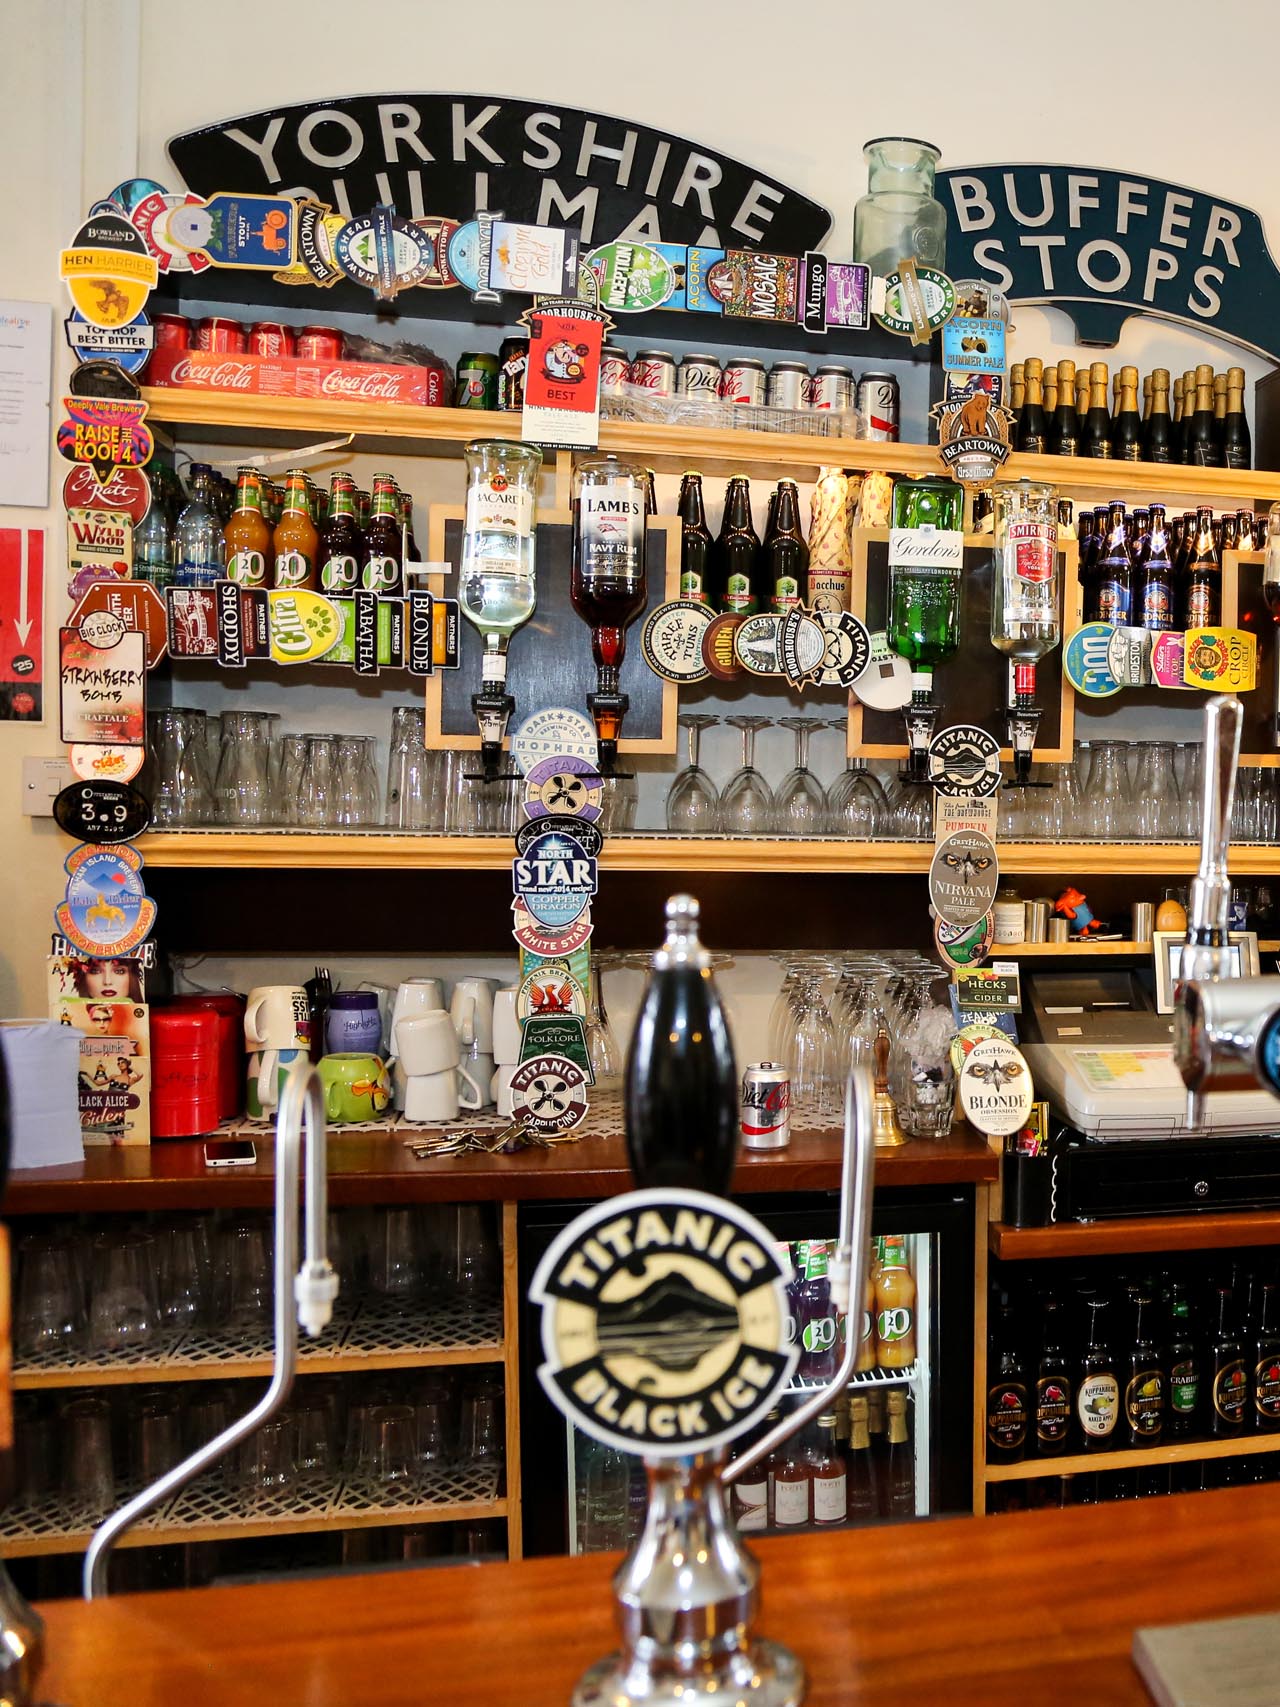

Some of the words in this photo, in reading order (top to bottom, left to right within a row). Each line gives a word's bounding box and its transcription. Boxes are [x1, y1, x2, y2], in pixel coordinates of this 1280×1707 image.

[223, 103, 785, 232] YORKSHIRE
[238, 215, 246, 248] STOUT
[949, 173, 1241, 267] BUFFER
[87, 227, 136, 242] BOWLAND
[301, 208, 330, 280] BEARTOWN
[64, 255, 93, 265] HEN
[95, 255, 153, 272] HARRIER
[339, 218, 375, 284] HAWKSHEAD
[401, 224, 432, 284] BREWERY
[440, 225, 450, 282] MONKEYTOWN
[609, 245, 633, 306] INCEPTION
[689, 250, 701, 306] ACORN
[752, 255, 779, 318] MOSAIC
[972, 235, 1225, 318] STOPS
[806, 264, 823, 319] Mungo
[924, 271, 953, 324] BREWERY
[946, 319, 1002, 331] ACORN
[77, 335, 104, 344] BEST
[108, 335, 146, 346] BITTER
[170, 358, 256, 389] Coca-Cola
[947, 354, 981, 367] SUMMER
[983, 356, 1004, 368] PALE
[321, 370, 401, 398] Coca-Cola
[547, 389, 576, 401] BEST
[68, 400, 93, 411] Deeply
[94, 401, 110, 411] Vale
[111, 403, 144, 415] Brewery
[75, 424, 119, 442] RAISE
[121, 427, 132, 444] THE
[74, 442, 119, 460] ROOF
[122, 446, 132, 462] 4
[944, 440, 1005, 459] BEARTOWN
[82, 485, 140, 506] Ratt
[587, 498, 640, 515] LAMB'S
[1009, 524, 1057, 540] SMIRNOFF
[589, 543, 615, 554] NAVY
[616, 543, 637, 555] RUM
[891, 535, 960, 562] Gordon's
[808, 577, 846, 591] Bacchus
[80, 628, 95, 639] BIG
[95, 622, 125, 636] CLOCK
[221, 585, 240, 663] SHODDY
[259, 604, 267, 641] PARTNERS
[272, 597, 312, 653] Citra
[358, 594, 373, 671] TABATHA
[413, 596, 429, 670] BLONDE
[448, 614, 456, 651] PARTNERS
[661, 618, 684, 661] THREE
[683, 624, 698, 660] TUNS
[714, 627, 733, 666] GOLDEN
[784, 612, 801, 678] MOORHOUSE'S
[841, 619, 866, 680] TITANIC
[1228, 636, 1241, 685] CROP
[61, 666, 144, 689] STRAWBERRY
[80, 690, 123, 703] BOMB
[526, 713, 556, 734] DARK
[566, 715, 591, 739] STAR
[517, 740, 597, 755] HOPHEAD
[937, 731, 993, 753] TITANIC
[976, 775, 995, 795] ICE
[81, 803, 128, 822] 3.9
[945, 822, 988, 833] PUMPKIN
[537, 849, 574, 859] NORTH
[86, 854, 117, 867] ISLAND
[117, 861, 140, 894] BREWERY
[516, 860, 595, 885] STAR
[934, 880, 992, 898] NIRVANA
[950, 897, 976, 906] PALE
[531, 903, 581, 911] DRAGON
[521, 928, 558, 951] WHITE
[561, 923, 586, 948] STAR
[520, 970, 547, 996] PHOENIX
[550, 969, 580, 993] BREWERY
[968, 980, 1007, 989] HECKS
[974, 994, 1002, 1002] CIDER
[527, 1034, 581, 1043] FOLKLORE
[973, 1046, 1017, 1057] GREYHAWK
[516, 1061, 579, 1085] TITANIC
[105, 1096, 129, 1107] ALICE
[969, 1095, 1028, 1110] BLONDE
[80, 1108, 124, 1126] Cider
[558, 1209, 768, 1292] TITANIC
[805, 1318, 837, 1353] J2O
[880, 1308, 911, 1341] J2O
[573, 1367, 710, 1438] BLACK
[711, 1354, 776, 1422] ICE
